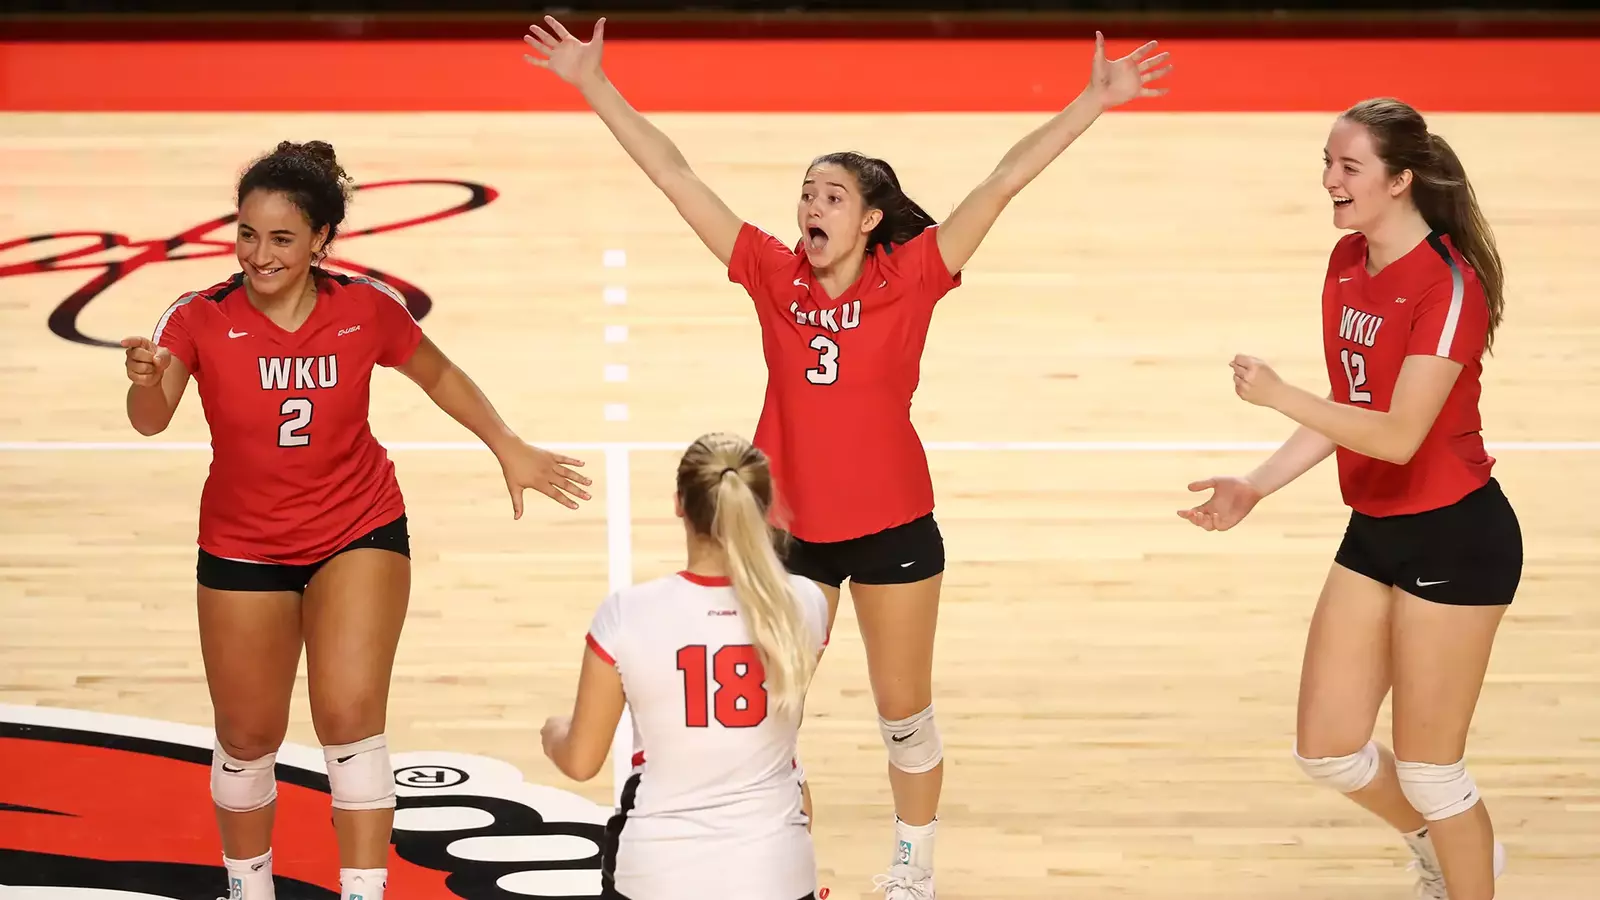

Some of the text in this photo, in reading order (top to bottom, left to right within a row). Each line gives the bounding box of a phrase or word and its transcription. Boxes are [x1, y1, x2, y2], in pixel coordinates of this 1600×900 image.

[1339, 304, 1383, 347] WKU
[258, 354, 338, 390] WKU
[805, 334, 840, 385] 3
[1340, 349, 1372, 404] 12
[278, 398, 313, 446] 2
[676, 645, 768, 728] 18
